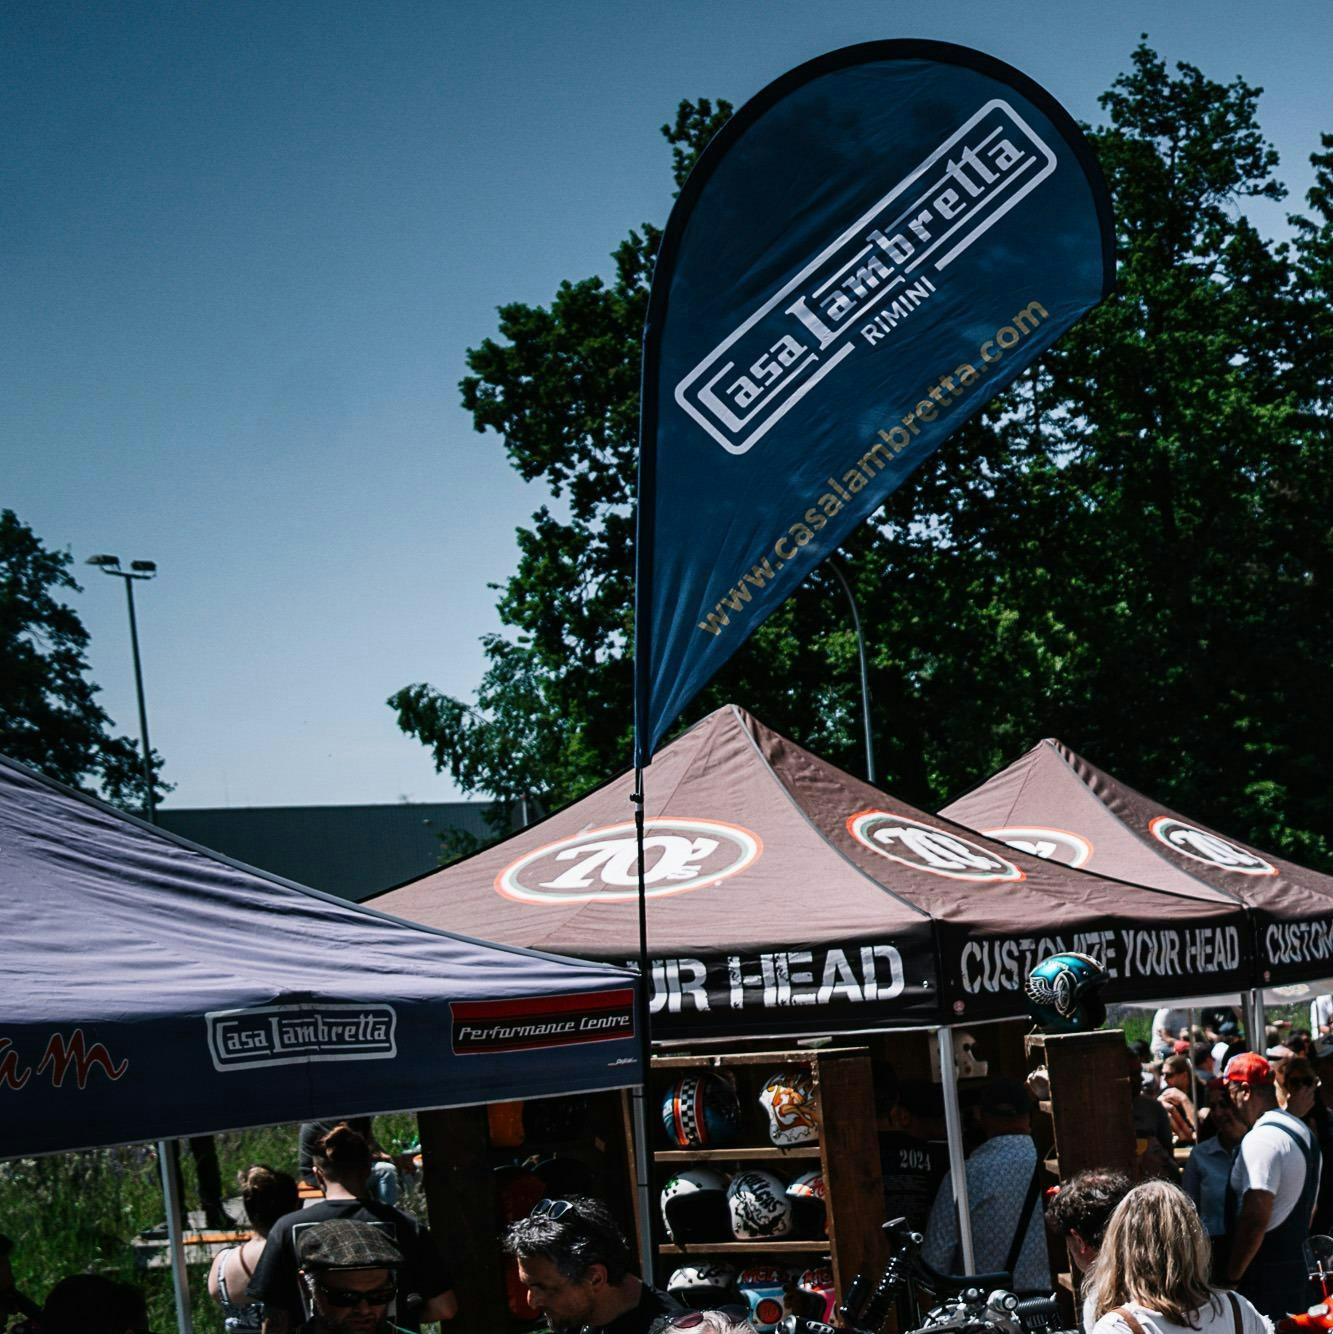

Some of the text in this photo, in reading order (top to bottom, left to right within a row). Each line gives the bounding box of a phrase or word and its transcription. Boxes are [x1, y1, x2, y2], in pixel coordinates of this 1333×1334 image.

[698, 127, 1036, 432] Casa Lambretta
[860, 276, 937, 346] RIMINI
[698, 300, 1049, 636] www.casalambretta.com
[727, 945, 906, 1009] HEAD
[1120, 929, 1183, 978] YOUR
[1184, 925, 1240, 974] HEAD
[267, 1013, 391, 1053] Lambretta
[458, 1015, 631, 1041] Performance Centre
[899, 1149, 932, 1171] 2024
